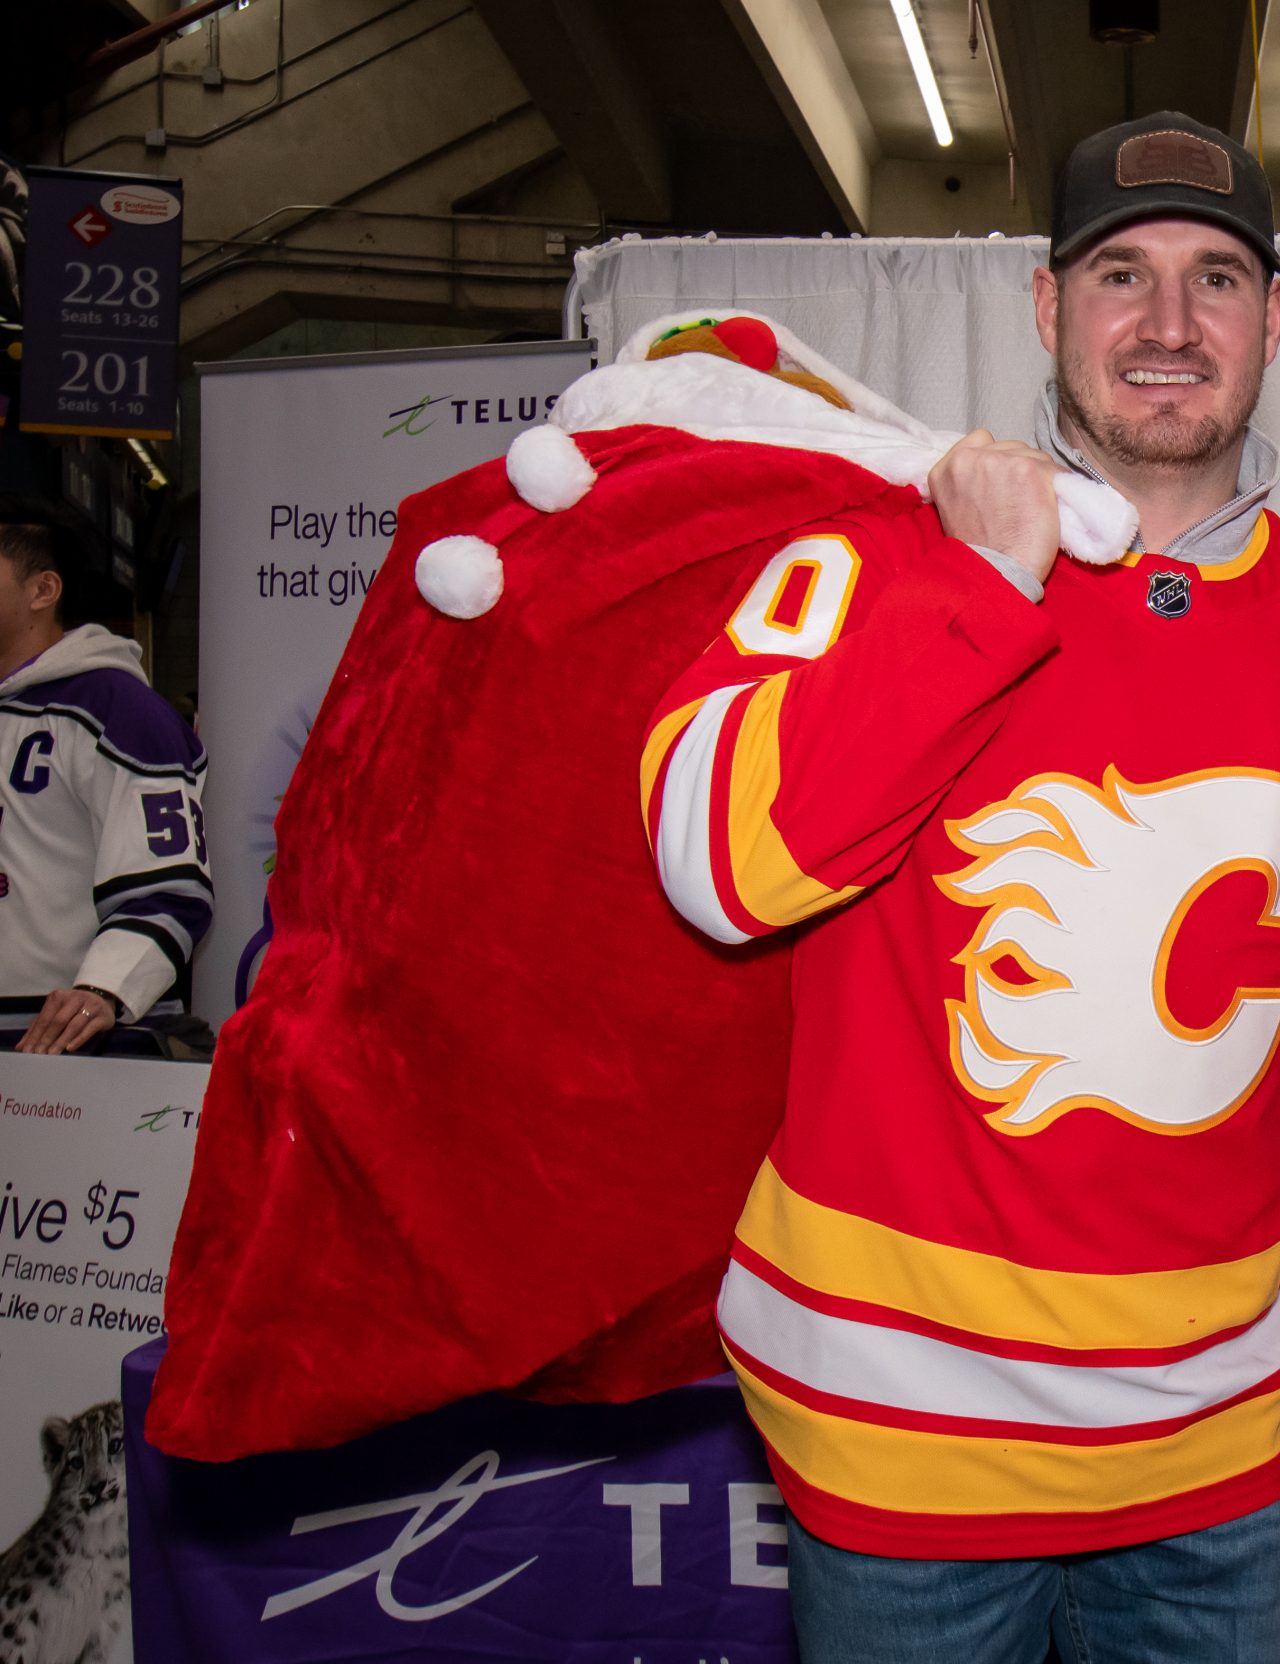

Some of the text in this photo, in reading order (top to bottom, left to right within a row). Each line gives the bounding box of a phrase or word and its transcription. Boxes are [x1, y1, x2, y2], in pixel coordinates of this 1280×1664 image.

[62, 262, 160, 309] 228
[61, 308, 159, 328] Seats 13-26
[59, 350, 149, 396] 201
[58, 397, 144, 415] Seats 1-10
[271, 502, 397, 548] Play the
[257, 562, 319, 597] that
[725, 534, 862, 660] 0
[1157, 584, 1183, 606] NHL
[9, 730, 54, 794] C
[4, 1098, 82, 1121] Foundation
[183, 1111, 201, 1129] T
[83, 1180, 140, 1250] $5
[2, 1254, 168, 1295] Flames Founda
[44, 1303, 68, 1324] or
[70, 1306, 84, 1327] a
